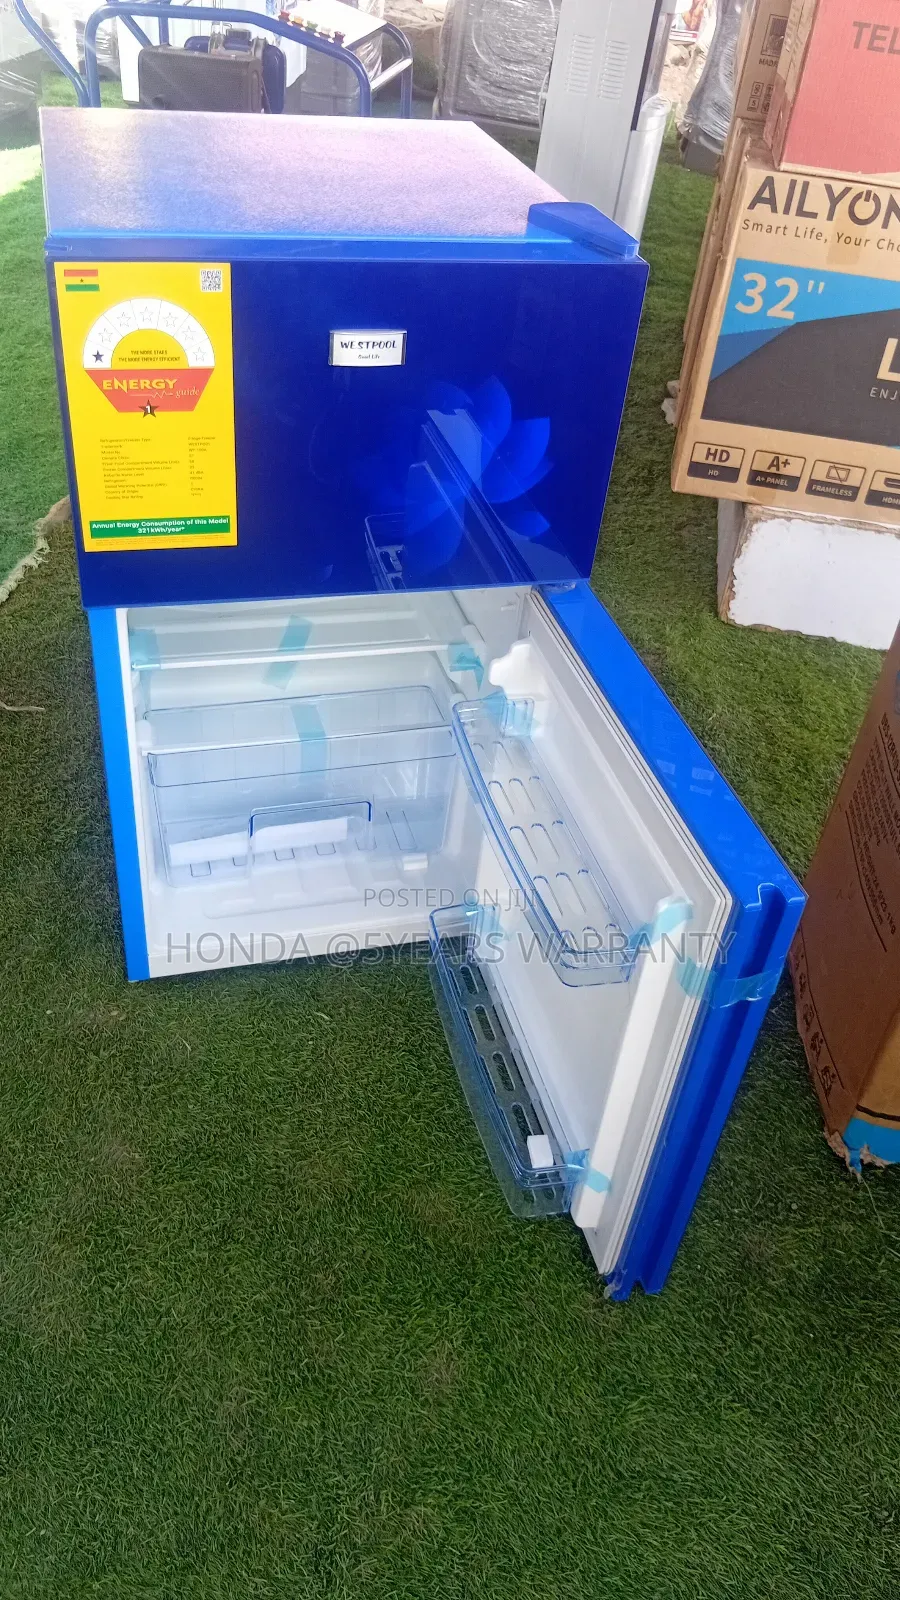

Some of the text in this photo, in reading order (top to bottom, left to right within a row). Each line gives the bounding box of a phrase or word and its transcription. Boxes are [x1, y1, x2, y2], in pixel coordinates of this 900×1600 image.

[742, 218, 788, 236] Smart
[794, 226, 828, 243] Life,
[836, 232, 871, 248] Your
[734, 272, 825, 320] 32"
[340, 340, 398, 350] WESTPOOL
[102, 378, 177, 393] ENERGY
[176, 387, 200, 399] guide
[146, 405, 151, 414] 1
[704, 447, 731, 464] HD
[767, 456, 791, 472] A+
[708, 469, 719, 477] HD
[766, 477, 789, 487] PANEL
[811, 484, 853, 498] FRAMELESS
